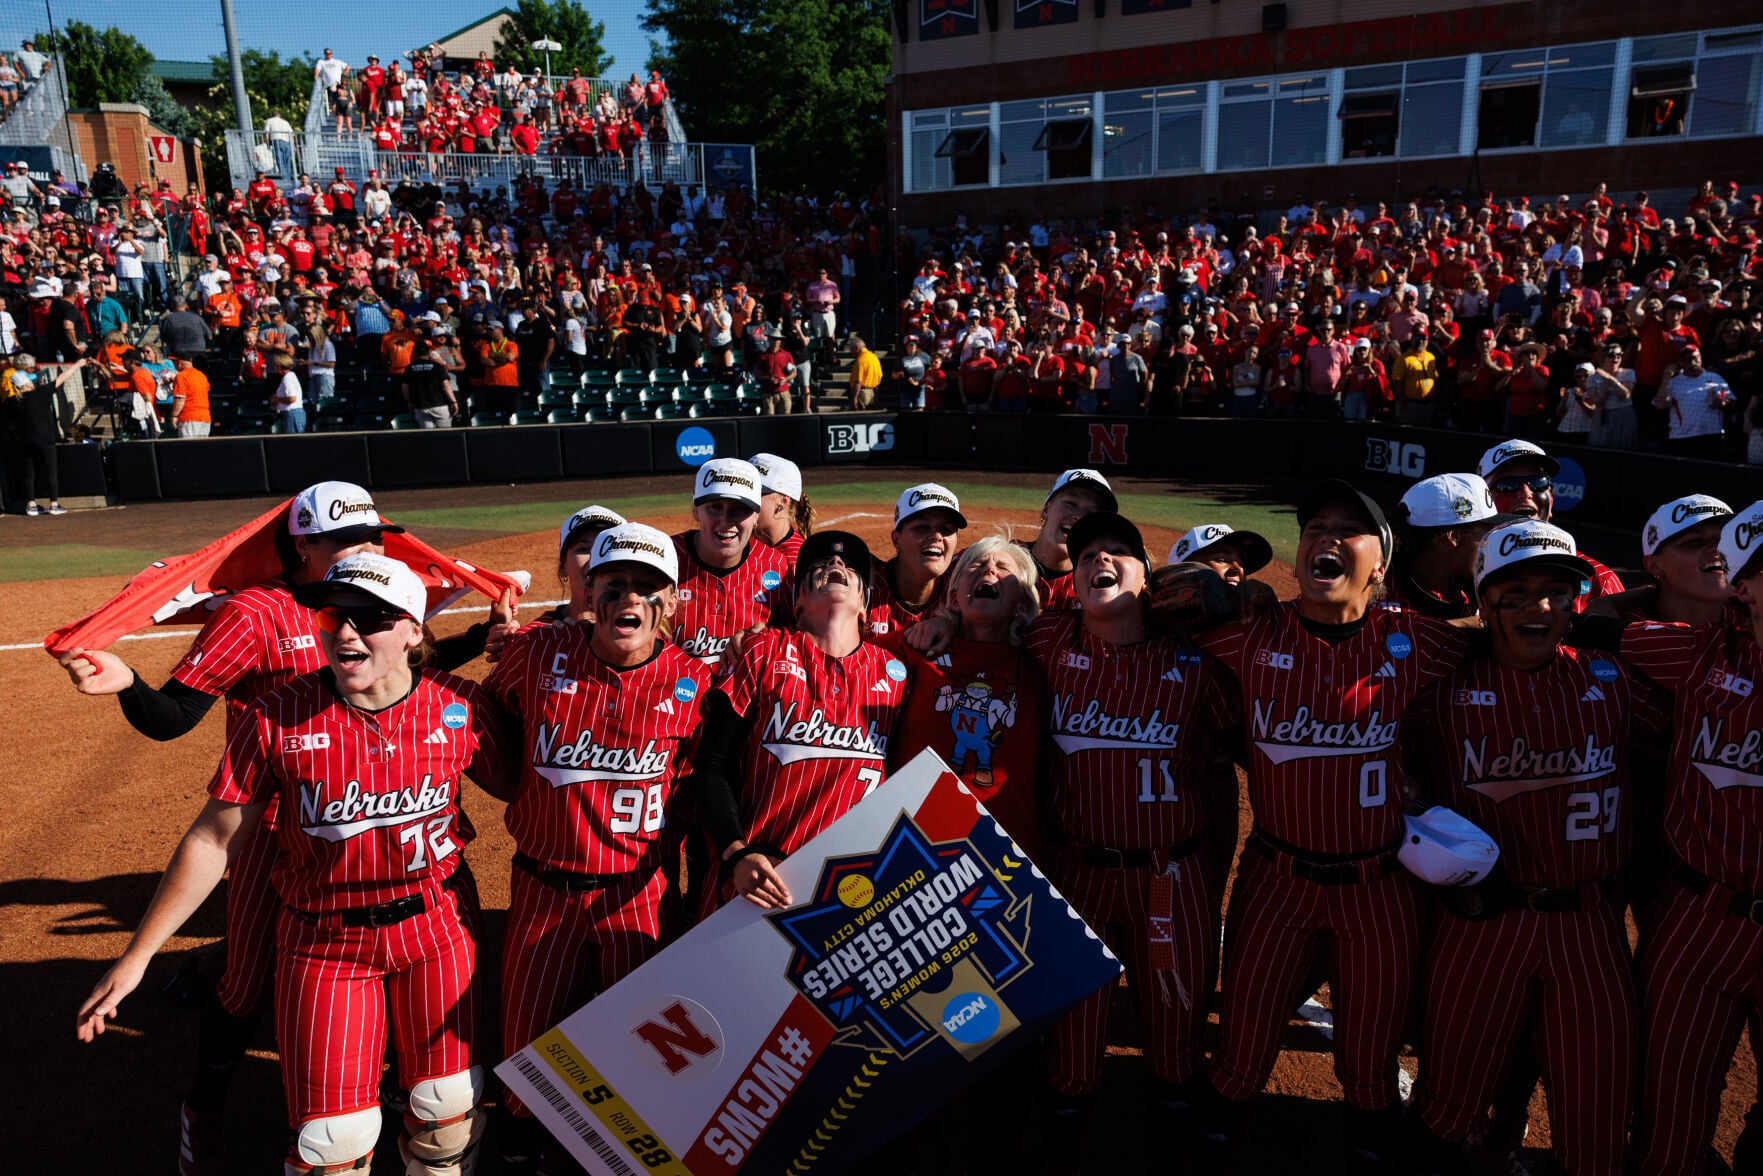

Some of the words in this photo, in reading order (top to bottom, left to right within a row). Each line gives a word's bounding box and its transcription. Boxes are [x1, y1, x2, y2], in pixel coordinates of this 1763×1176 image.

[1066, 32, 1273, 85] NEBRASKA
[1284, 5, 1508, 62] SOFTBALL
[680, 444, 715, 457] NCAA
[1087, 423, 1129, 465] N
[702, 468, 754, 490] Champions
[598, 534, 665, 558] Champions
[1499, 533, 1572, 557] Champions
[551, 652, 568, 675] C
[888, 667, 906, 678] NCAA
[1390, 644, 1411, 653] NCAA
[1594, 668, 1618, 677] NCAA
[761, 700, 888, 754] Nebraska
[955, 712, 979, 736] N
[1049, 691, 1181, 745] Nebraska
[1252, 697, 1399, 748] Nebraska
[533, 720, 672, 773] Nebraska
[1462, 732, 1618, 782] Nebraska
[299, 773, 451, 826] Nebraska
[856, 766, 882, 799] 7
[1136, 756, 1180, 804] 11
[608, 782, 666, 835] 98
[1564, 784, 1622, 842] 29
[399, 812, 458, 873] 72
[853, 868, 926, 926] OKLAHOMA
[887, 852, 984, 939] WORLD
[802, 921, 892, 1000] SERIES
[823, 922, 855, 952] CITY
[857, 906, 968, 1001] COLLEGE
[943, 931, 979, 964] 2026
[879, 962, 941, 1010] WOMEN'S
[633, 1000, 720, 1076] N
[943, 995, 988, 1033] NCAA
[546, 1043, 591, 1085] SECTION
[582, 1084, 615, 1106] 5
[609, 1111, 639, 1135] ROW
[626, 1134, 673, 1169] 28
[703, 1025, 813, 1166] #WCWS
